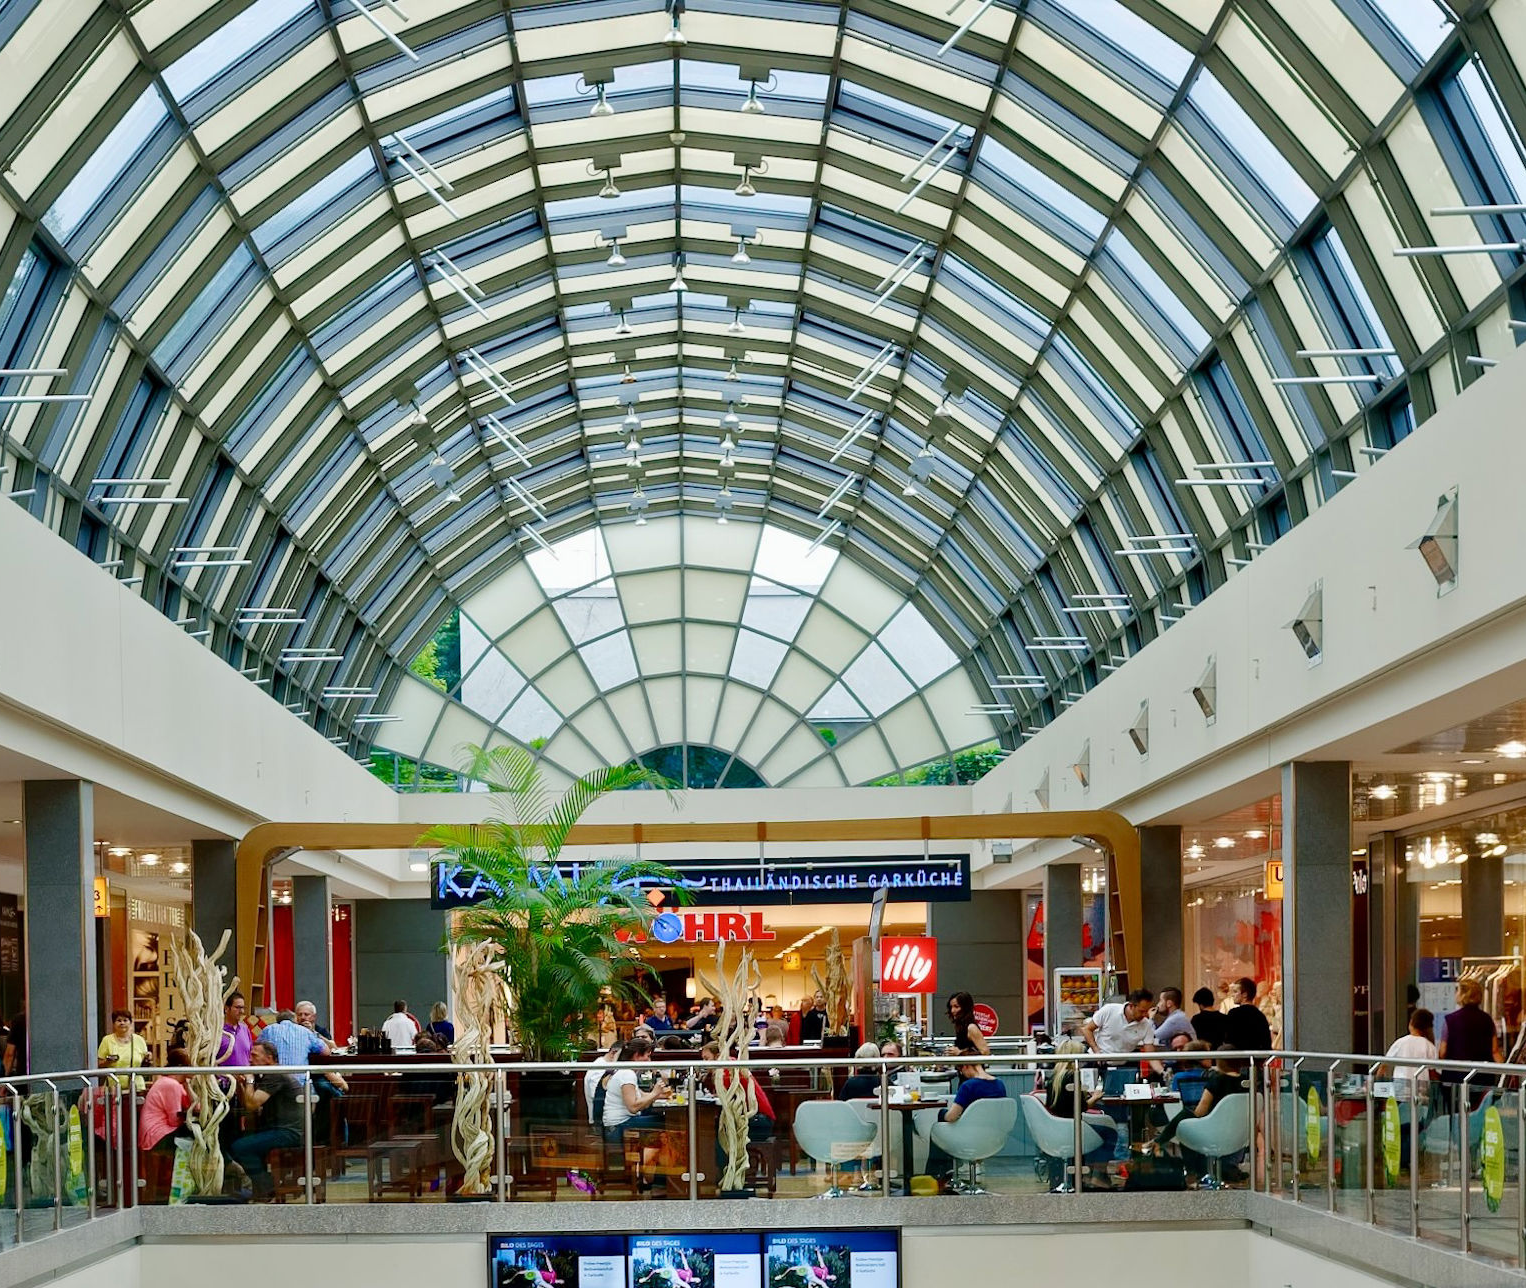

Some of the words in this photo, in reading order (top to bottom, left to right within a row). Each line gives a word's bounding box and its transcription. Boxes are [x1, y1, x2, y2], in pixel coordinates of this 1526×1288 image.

[710, 873, 858, 891] THAILÄNDISCHE
[868, 869, 963, 888] GARKÜCHE
[883, 944, 932, 988] illy
